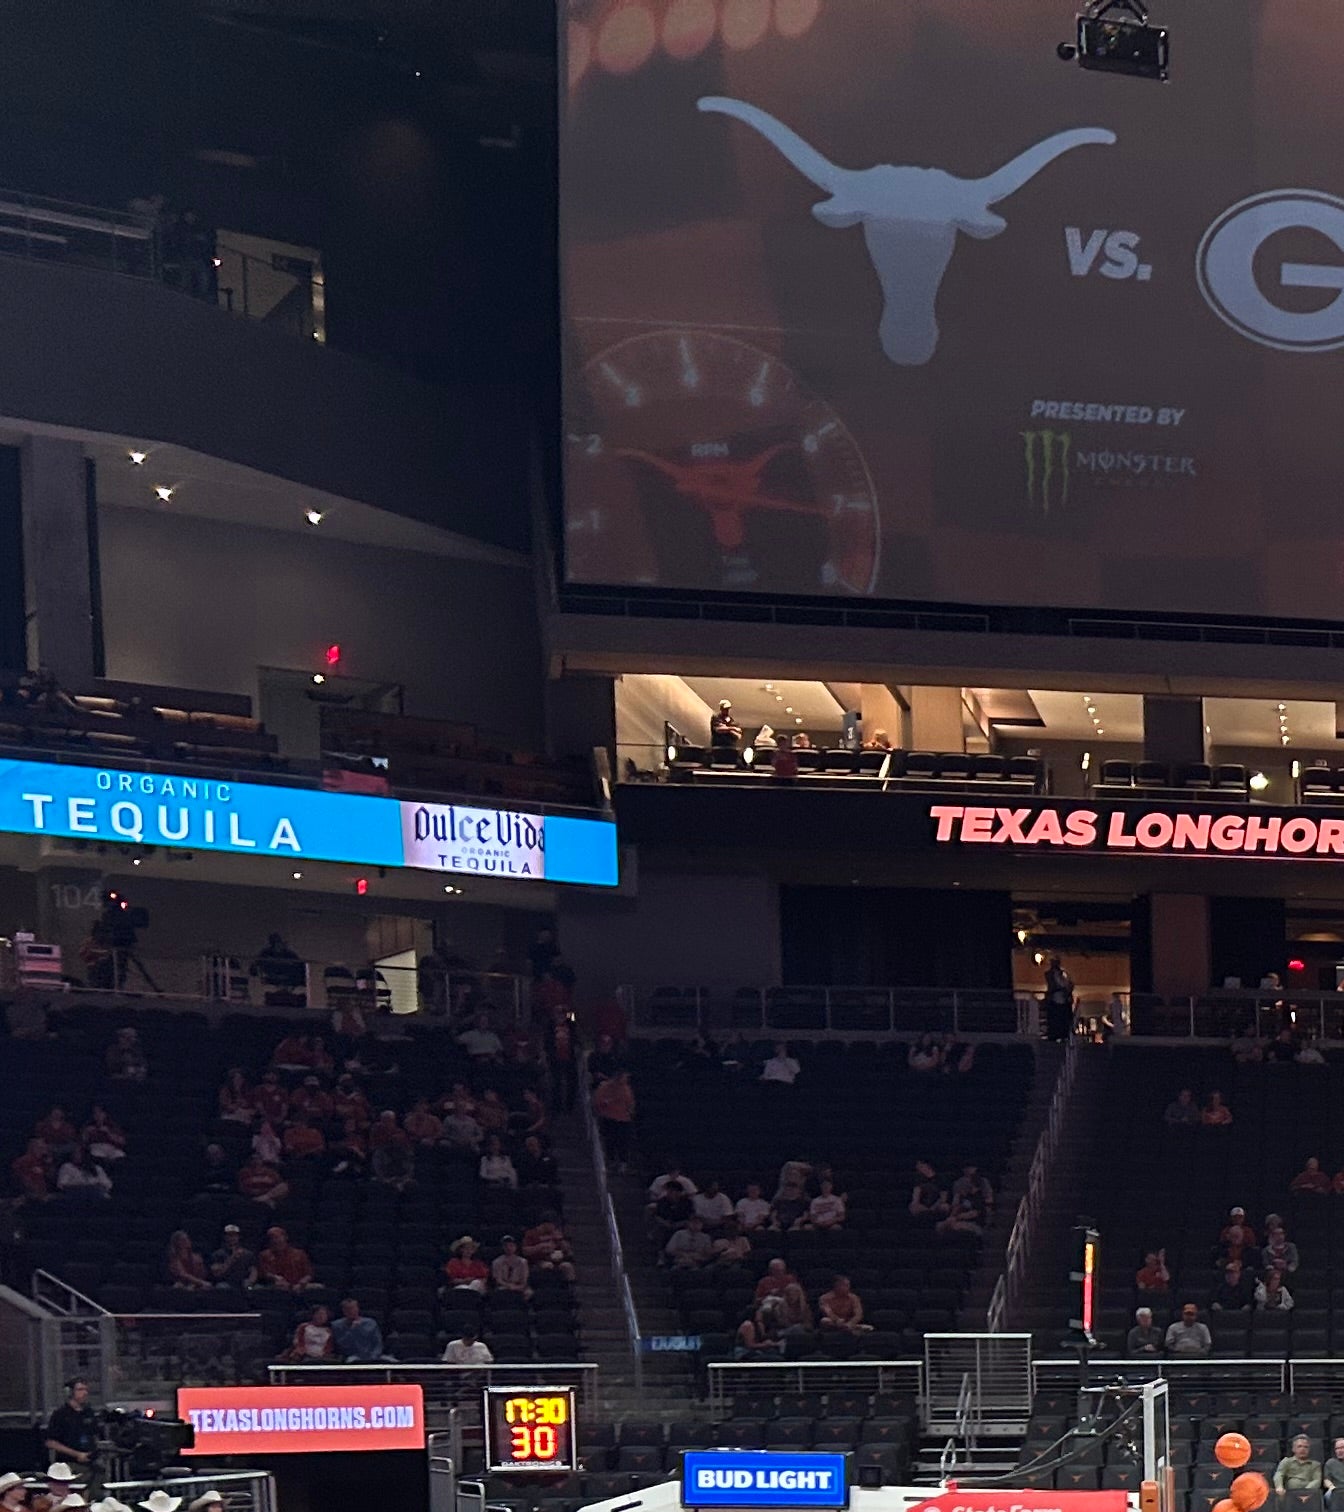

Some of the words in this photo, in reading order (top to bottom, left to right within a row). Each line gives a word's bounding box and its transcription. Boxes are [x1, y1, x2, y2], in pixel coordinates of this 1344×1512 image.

[1064, 227, 1153, 281] VS.
[1029, 399, 1153, 424] PRESENTED
[1155, 407, 1187, 426] BY
[1075, 449, 1197, 476] MONSTER
[96, 771, 233, 802] ORGANIC
[23, 794, 302, 853] TEQUILA
[930, 806, 1098, 846] TEXAS
[438, 854, 532, 875] TEQUILA
[461, 846, 510, 858] ORGANIC
[51, 884, 102, 910] 104
[189, 1405, 414, 1432] TEXASLONGHORNS.COM
[505, 1397, 566, 1424] 17:30
[511, 1426, 555, 1458] 30
[698, 1469, 754, 1489] BUD
[756, 1470, 831, 1490] LIGHT
